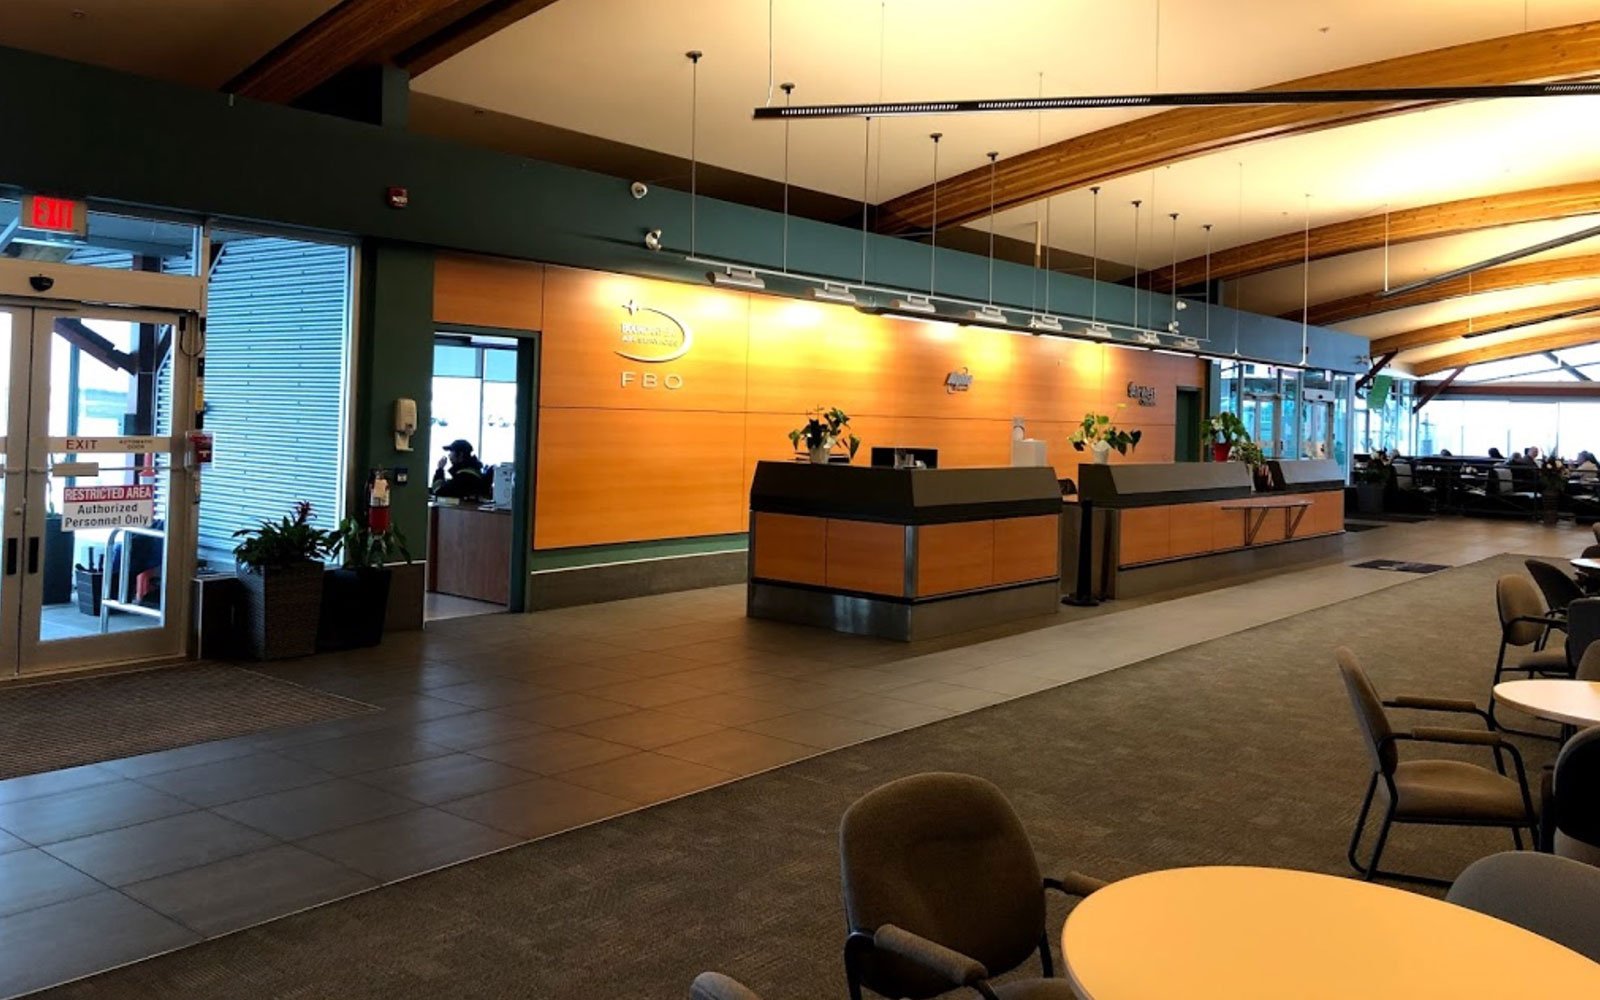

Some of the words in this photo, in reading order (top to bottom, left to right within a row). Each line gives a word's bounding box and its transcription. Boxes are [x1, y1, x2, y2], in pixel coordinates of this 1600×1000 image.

[32, 195, 75, 231] EXIT
[621, 371, 683, 390] FBO
[66, 439, 98, 450] EXIT
[64, 487, 125, 501] RESTRICTED
[126, 486, 152, 499] AREA
[77, 503, 138, 515] Authorized
[65, 515, 122, 528] Personnel
[125, 514, 149, 526] Only
